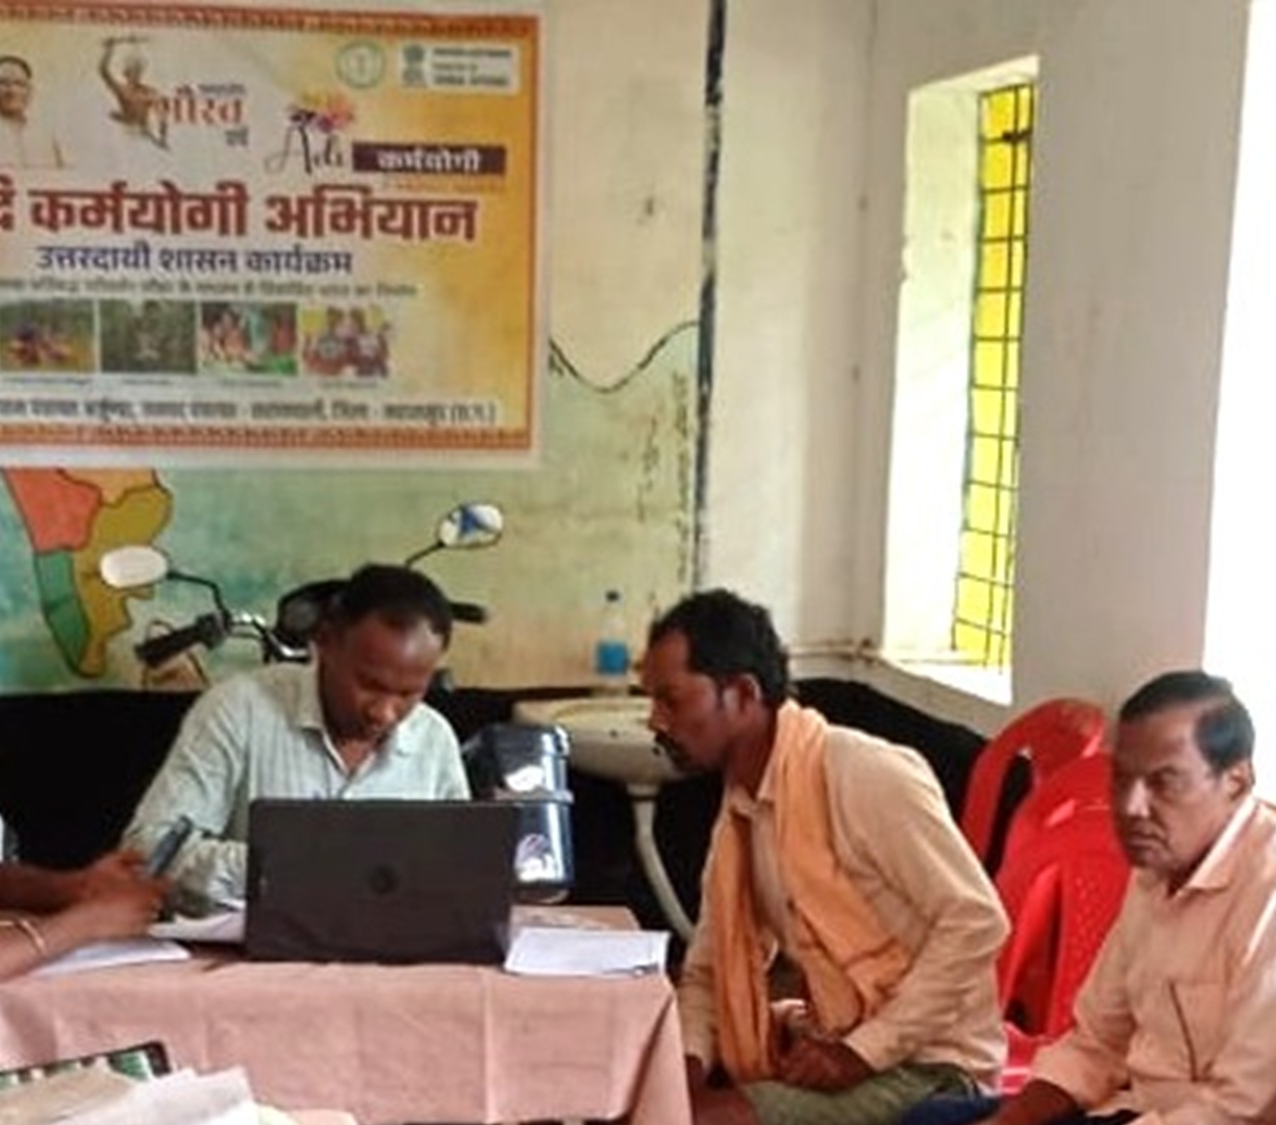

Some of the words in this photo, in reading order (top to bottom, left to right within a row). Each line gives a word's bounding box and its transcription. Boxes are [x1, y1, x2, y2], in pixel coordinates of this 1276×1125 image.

[376, 145, 481, 172] कर्मयोगी
[26, 179, 249, 235] कर्मयोगी
[265, 183, 478, 241] अभियान
[35, 240, 151, 271] उत्तरदायी
[158, 247, 238, 273] शासन
[245, 243, 353, 275] कार्यक्रम
